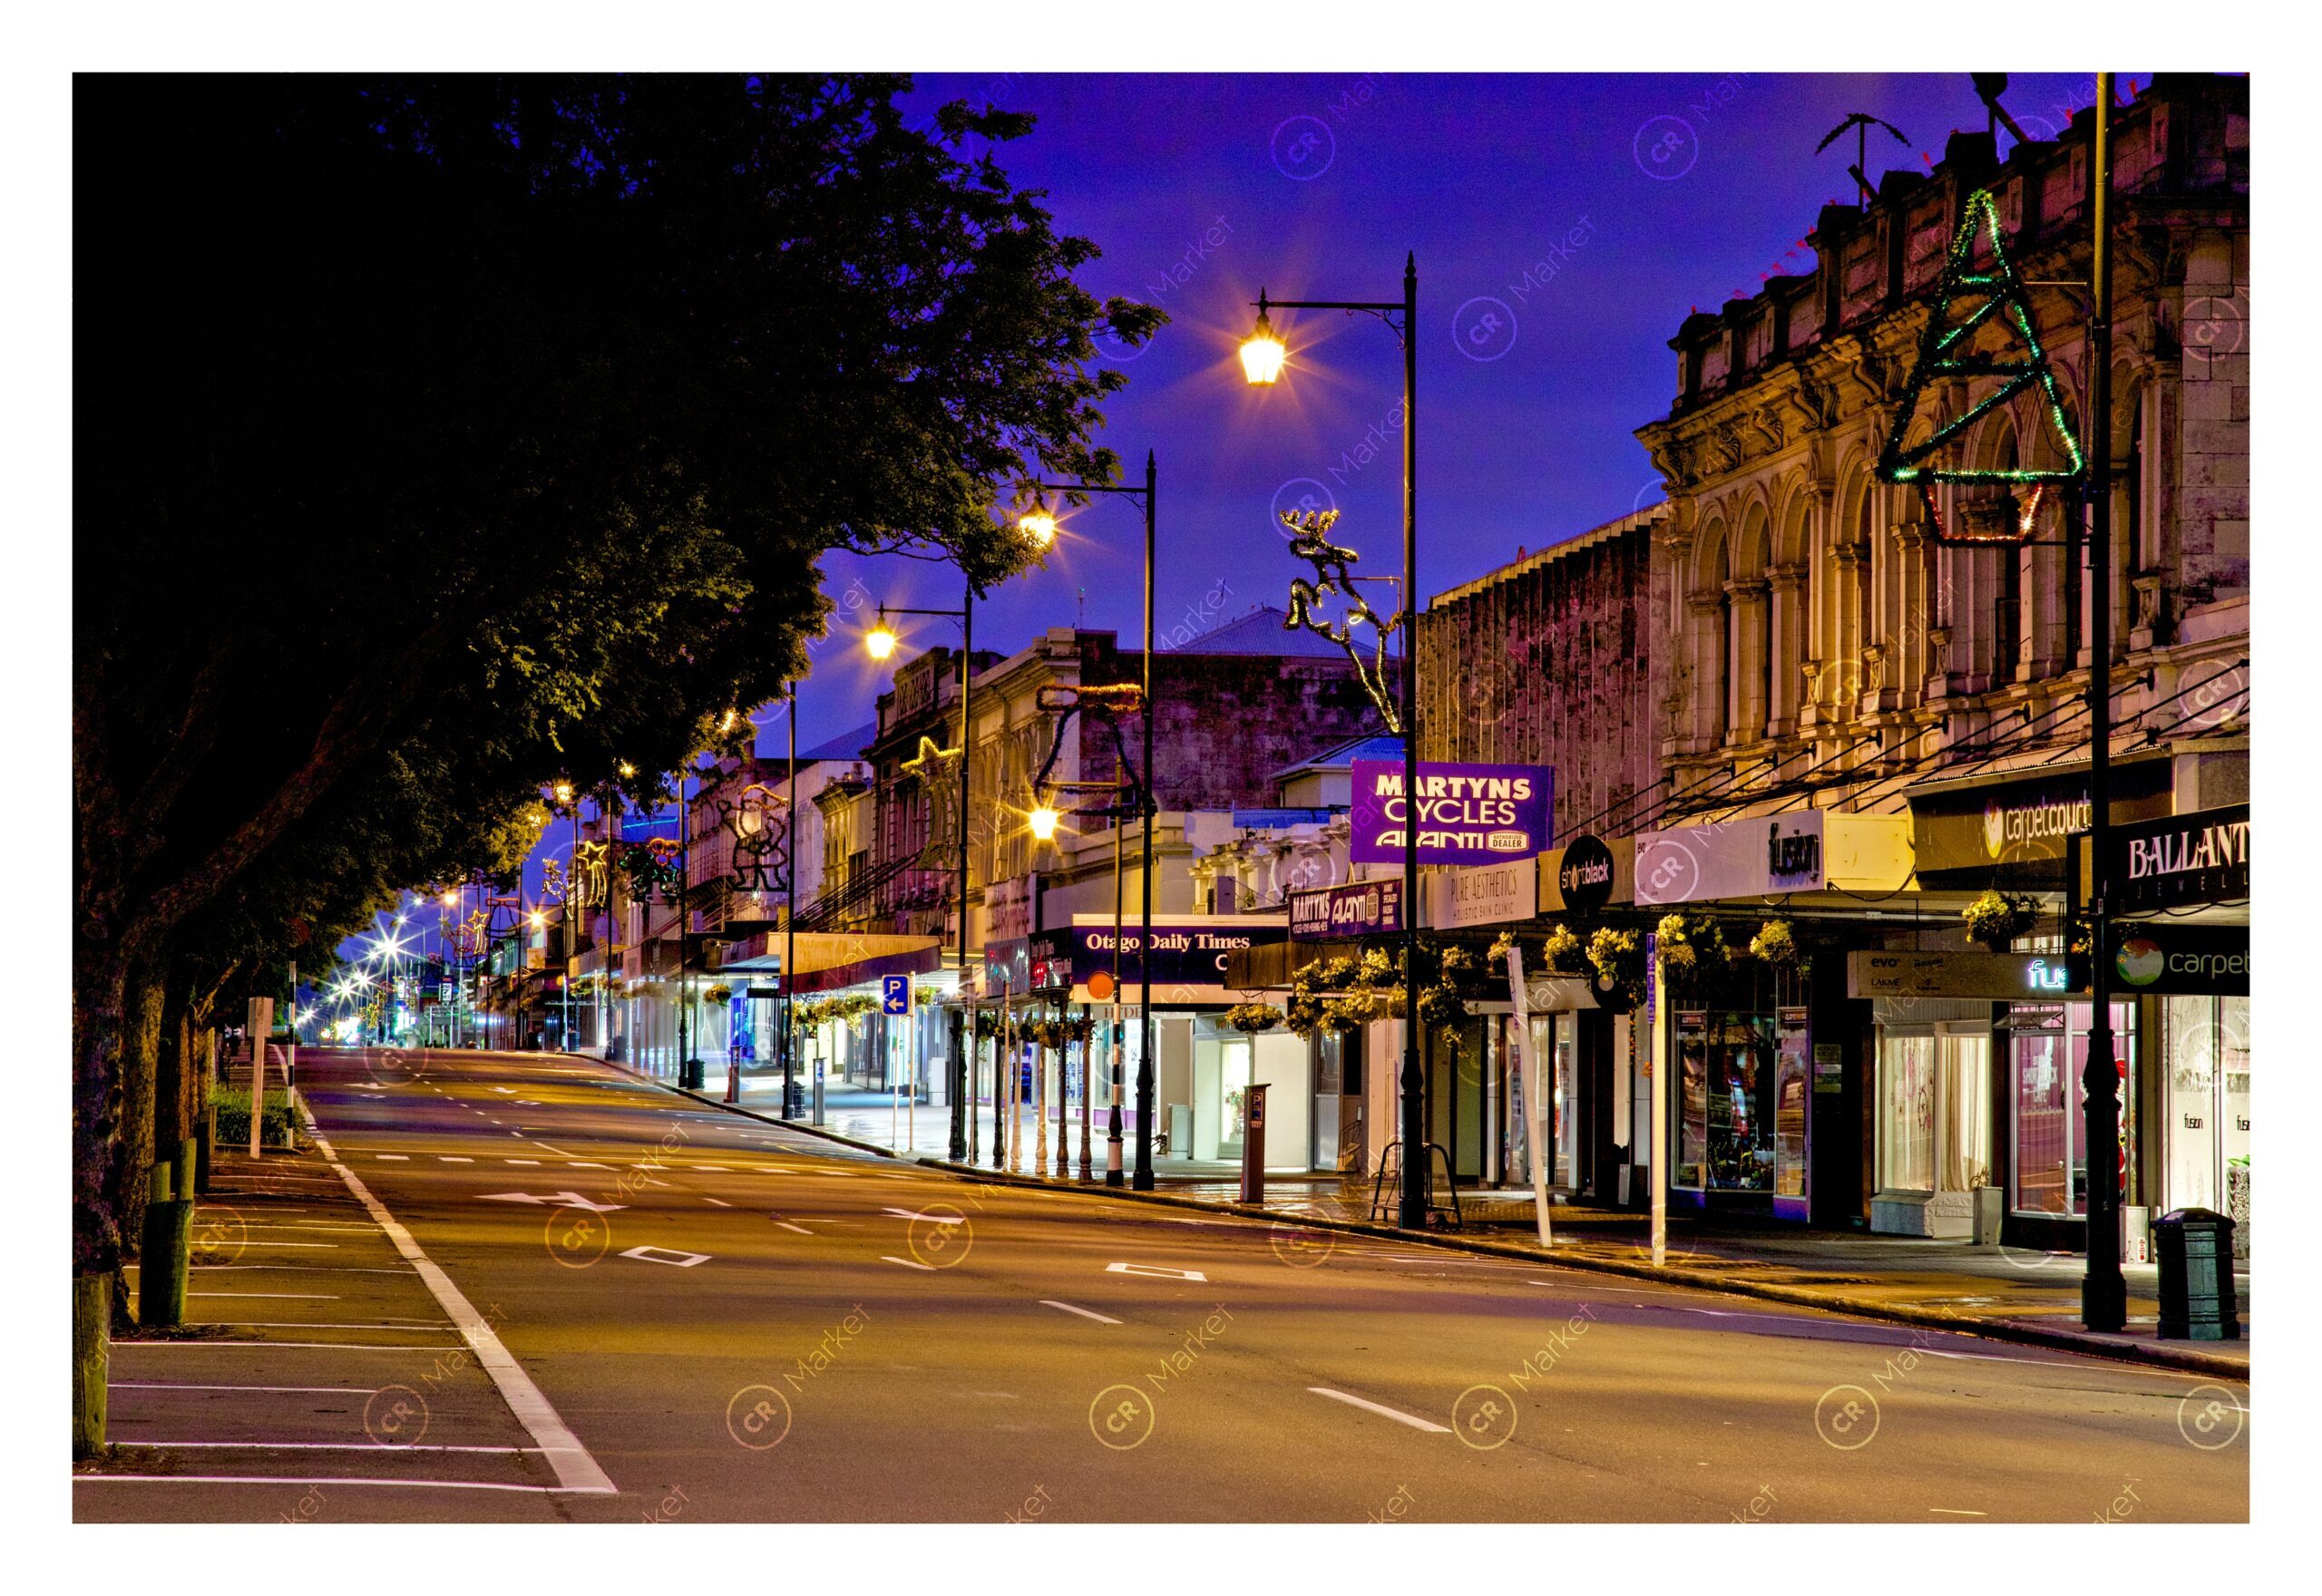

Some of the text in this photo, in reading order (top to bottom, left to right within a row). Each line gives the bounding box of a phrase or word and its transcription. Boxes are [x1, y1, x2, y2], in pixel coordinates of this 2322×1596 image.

[1376, 774, 1531, 801] MARTYNS
[1384, 798, 1516, 825] CYCLES
[1492, 839, 1522, 848] DEALER
[2129, 822, 2249, 879] BALLANT
[1450, 869, 1517, 903] PURE AESTHETICS
[1293, 891, 1331, 923] MARTYNS
[1479, 905, 1492, 918] SKIN
[1495, 902, 1514, 916] CLINIC
[1087, 933, 1251, 953] Otago Daily Times
[890, 980, 902, 995] P
[1254, 1095, 1262, 1105] P
